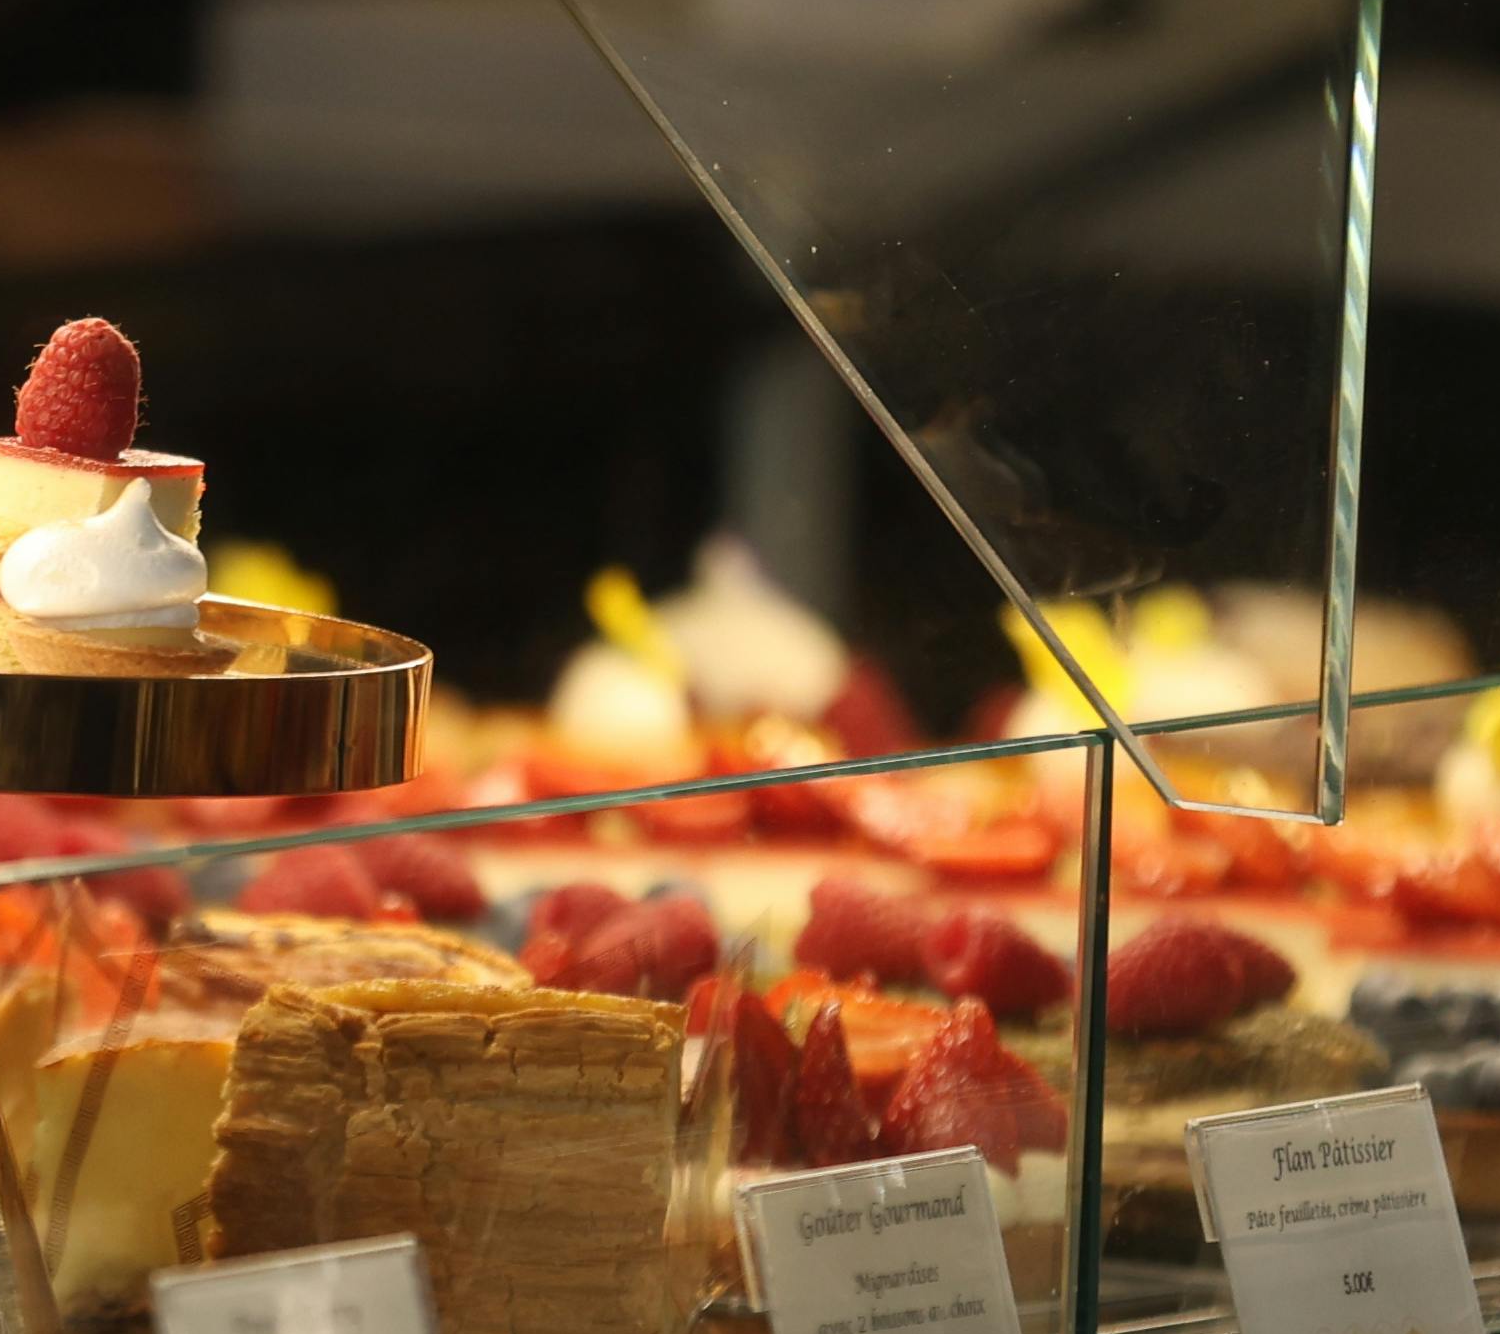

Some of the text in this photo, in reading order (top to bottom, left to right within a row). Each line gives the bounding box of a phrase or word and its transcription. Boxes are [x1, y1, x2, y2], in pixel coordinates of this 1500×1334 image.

[1272, 1134, 1396, 1181] Flan Pâtissier
[798, 1184, 966, 1246] Goûter Gourmand
[1246, 1209, 1275, 1231] Pâte
[1338, 1198, 1370, 1218] crème
[1343, 1270, 1375, 1296] 5.00€
[858, 1315, 867, 1334] 2
[950, 1293, 986, 1319] choix
